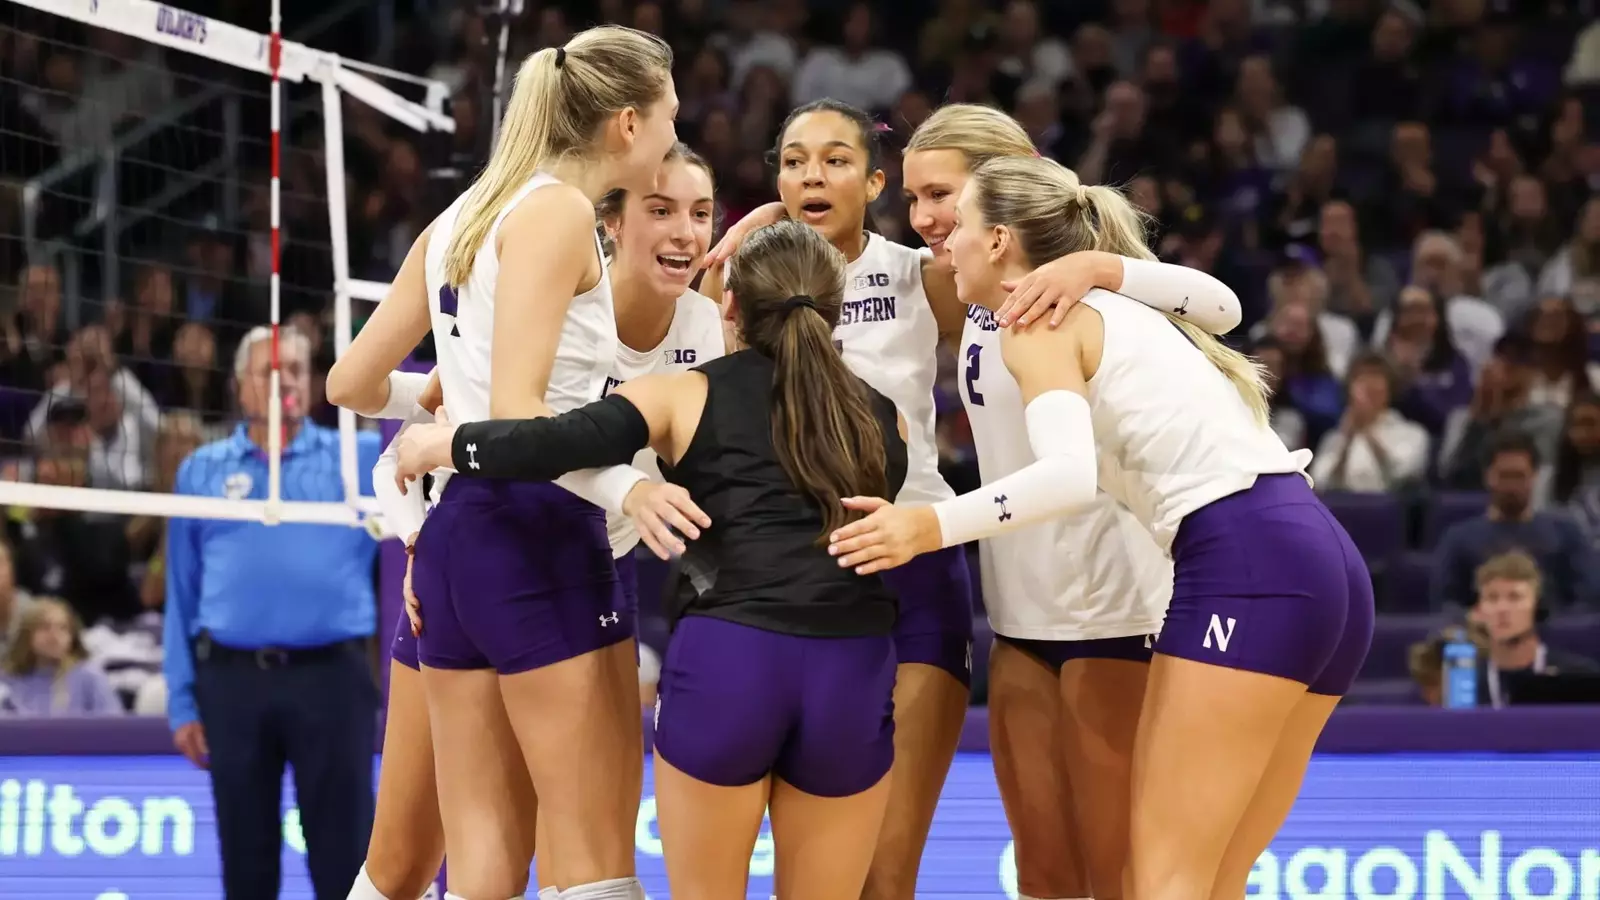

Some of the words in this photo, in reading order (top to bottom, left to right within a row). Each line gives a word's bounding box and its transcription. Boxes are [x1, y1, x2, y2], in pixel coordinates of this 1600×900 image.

[836, 297, 896, 325] STERN
[966, 343, 985, 406] 2
[1202, 613, 1237, 652] N
